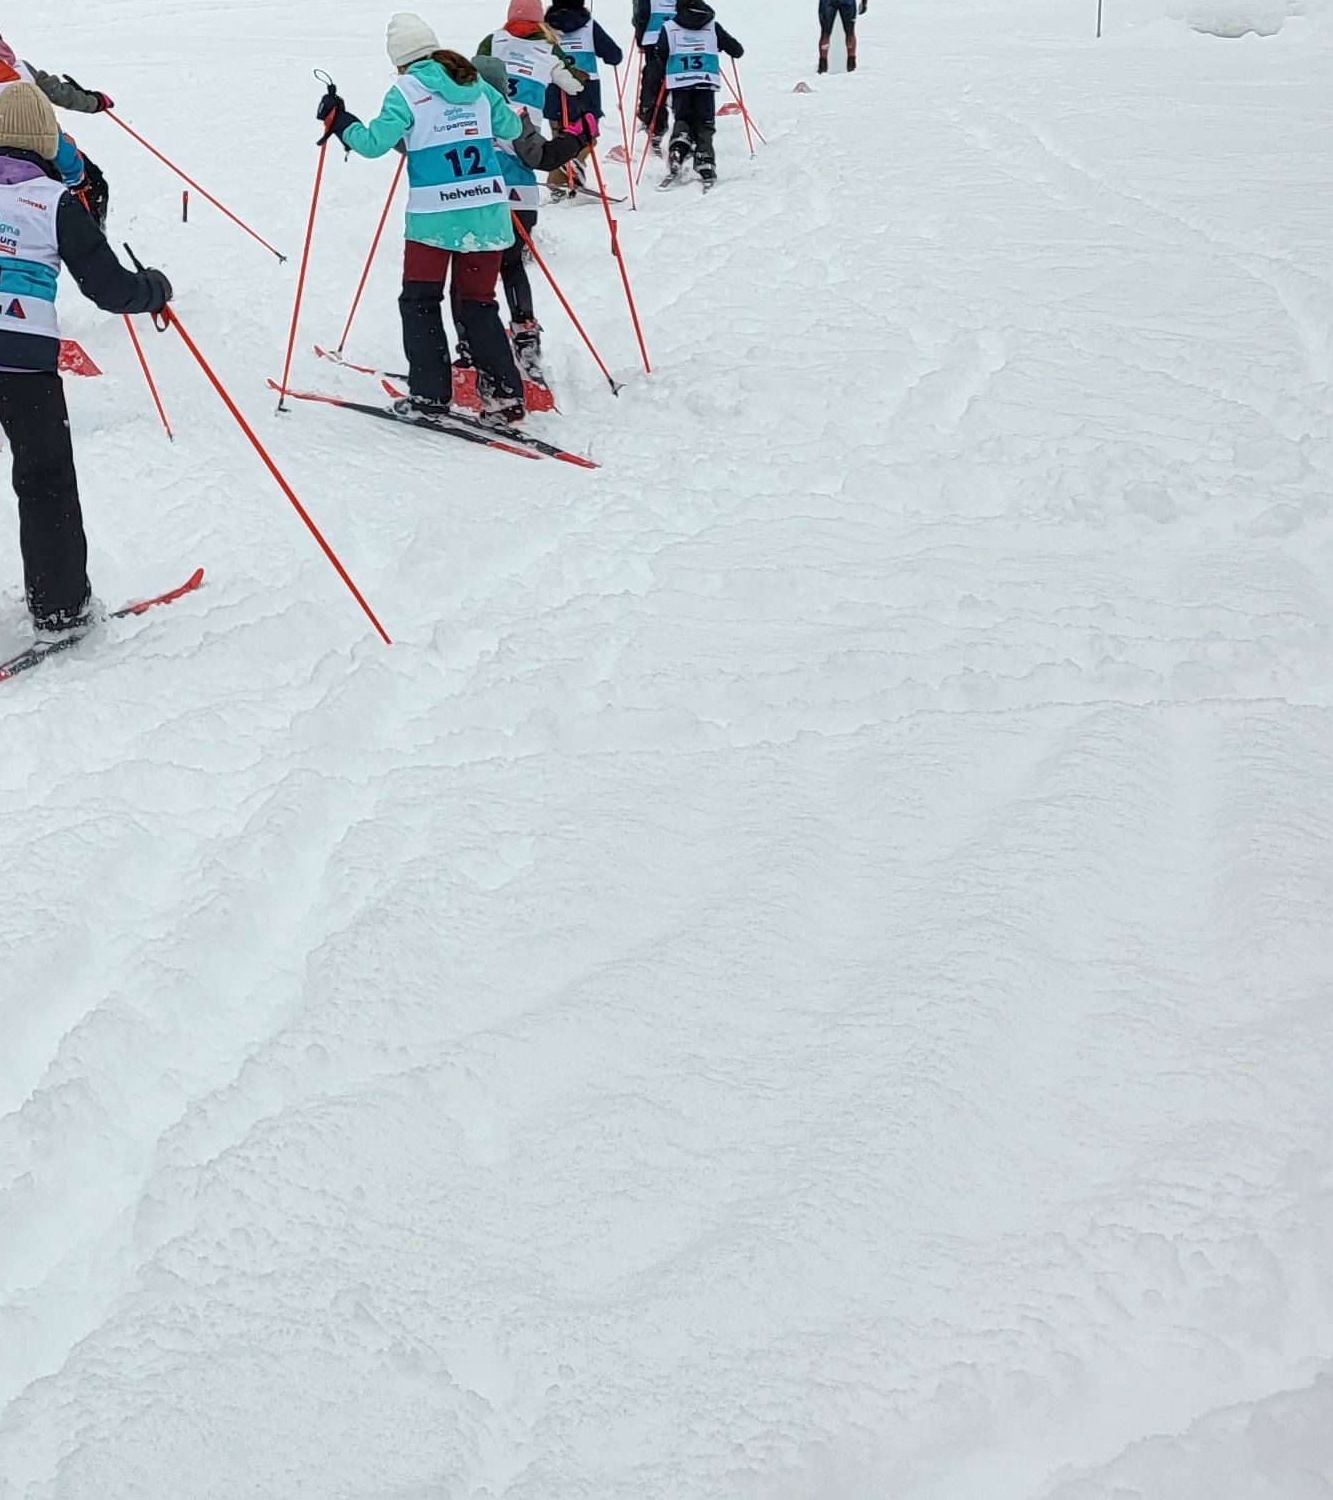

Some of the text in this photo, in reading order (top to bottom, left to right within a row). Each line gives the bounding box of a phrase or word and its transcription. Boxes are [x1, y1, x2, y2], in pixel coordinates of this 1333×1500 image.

[680, 56, 704, 71] 13
[444, 145, 486, 178] 12
[440, 185, 491, 201] helvetia
